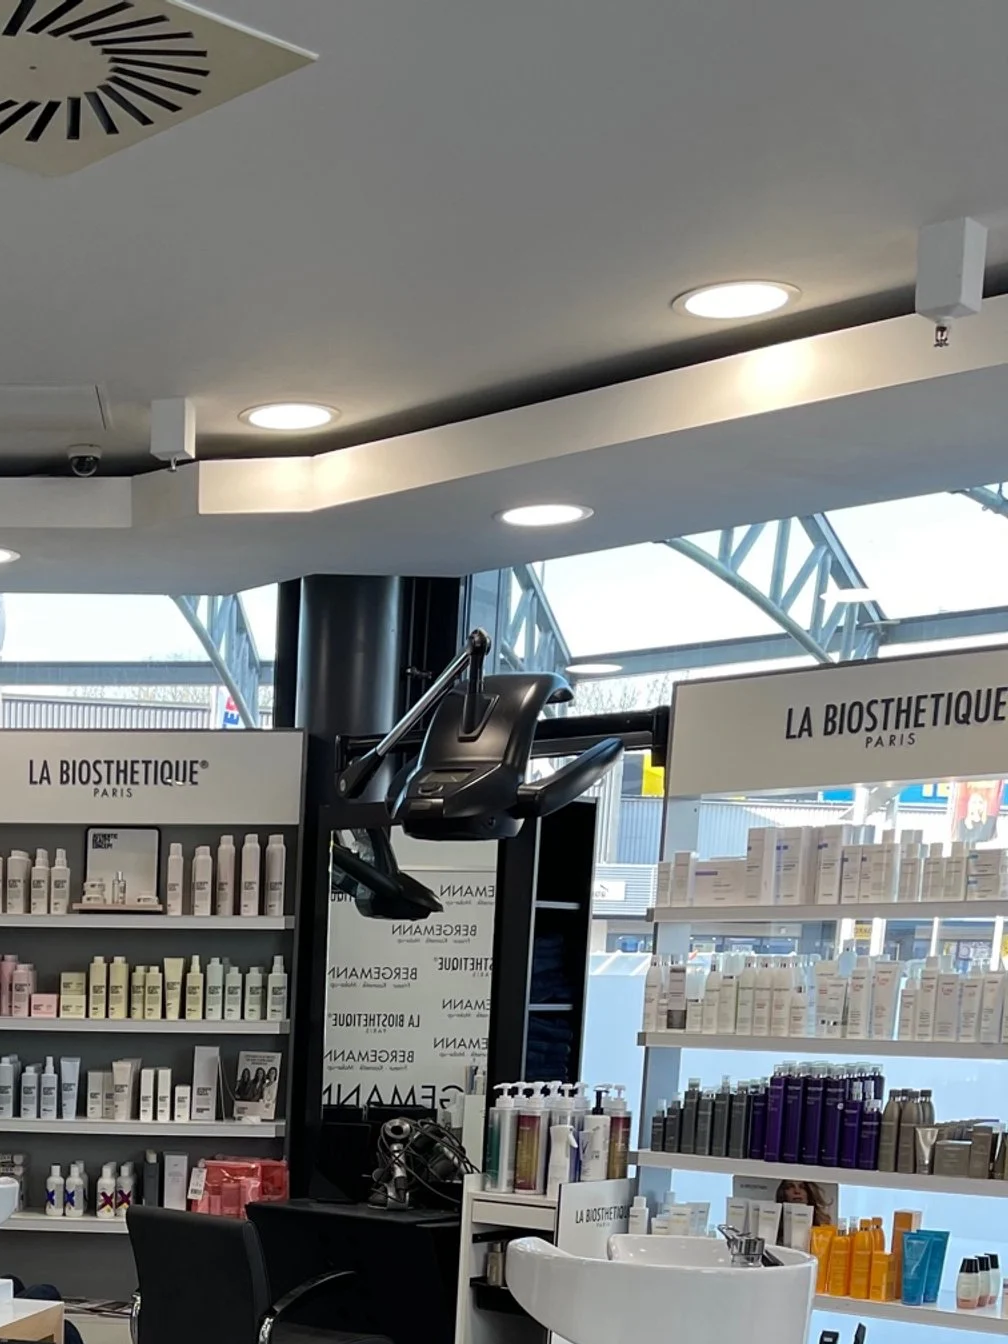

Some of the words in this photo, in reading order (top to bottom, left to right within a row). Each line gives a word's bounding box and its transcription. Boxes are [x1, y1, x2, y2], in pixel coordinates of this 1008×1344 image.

[786, 706, 813, 740] LA
[823, 686, 1008, 737] BIOSTHETIQUE
[865, 732, 916, 749] PARIS
[29, 760, 52, 786] LA
[93, 787, 133, 799] PARIS
